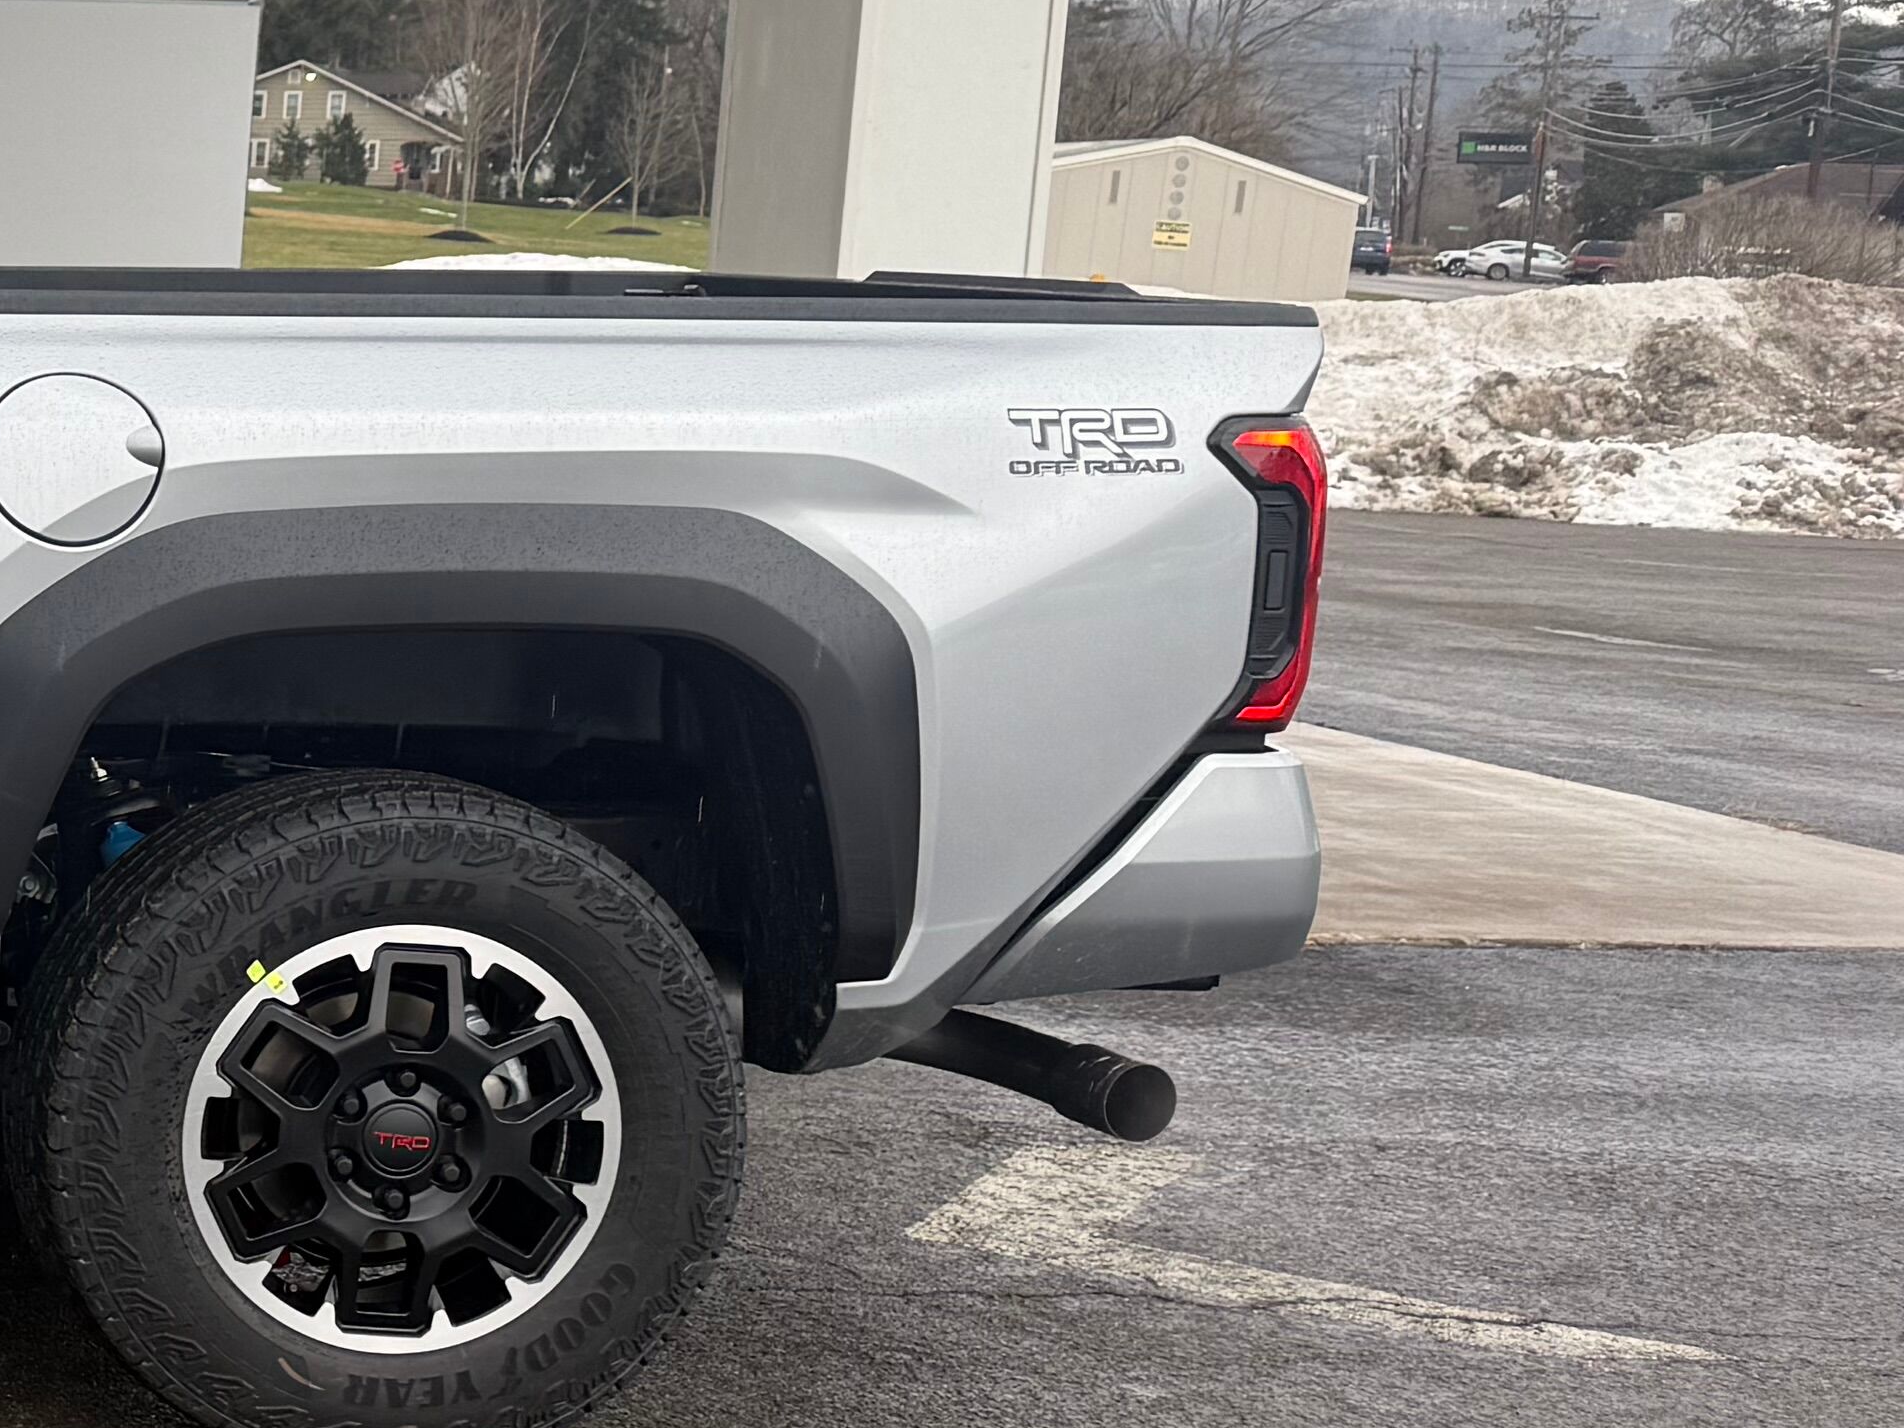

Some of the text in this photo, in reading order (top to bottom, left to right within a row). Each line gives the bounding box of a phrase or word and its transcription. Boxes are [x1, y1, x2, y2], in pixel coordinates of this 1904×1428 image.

[1498, 144, 1528, 153] BLOCK
[1007, 408, 1178, 460] TRD
[1008, 458, 1185, 477] OFF ROAD
[178, 877, 479, 1022] WRANGLER
[373, 1131, 431, 1152] TRD
